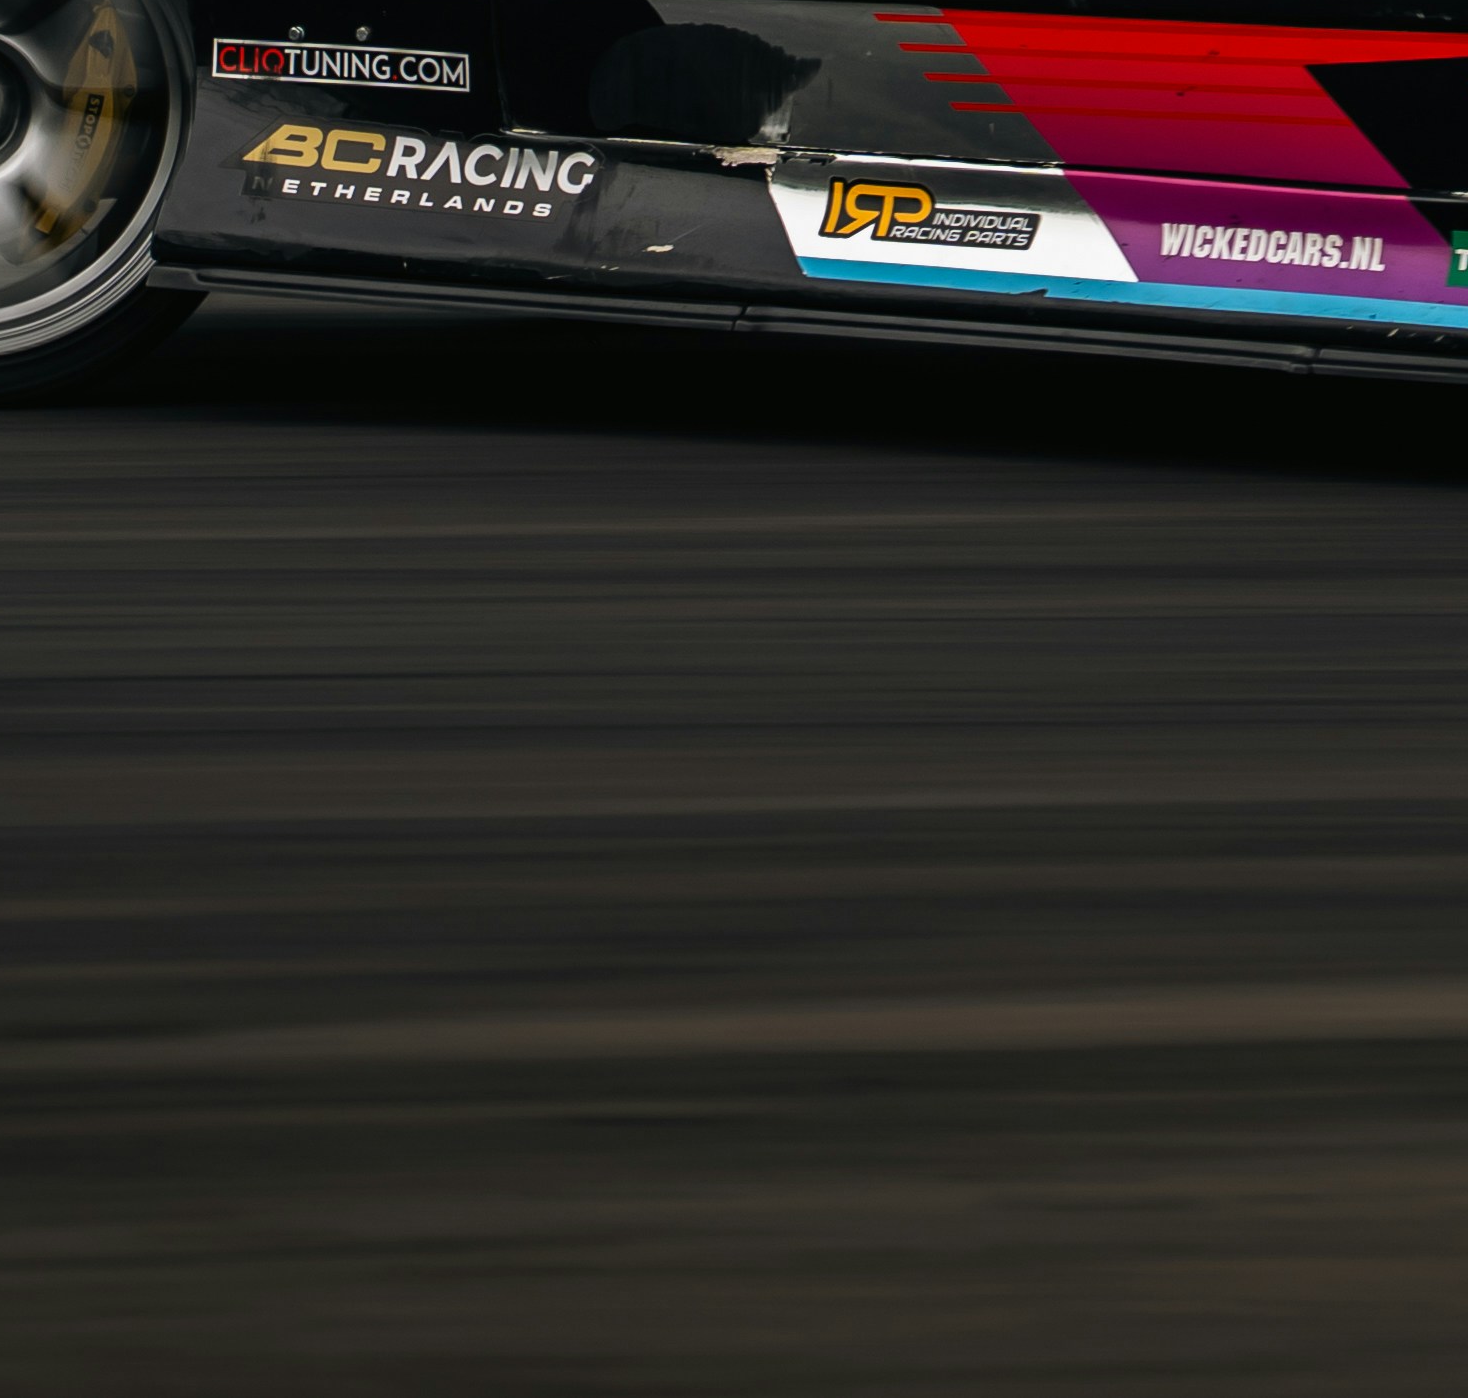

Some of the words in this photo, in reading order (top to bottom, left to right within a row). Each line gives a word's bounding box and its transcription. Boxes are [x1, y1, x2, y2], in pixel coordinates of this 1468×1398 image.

[933, 213, 1033, 232] INDIVIDUAL
[890, 226, 961, 242] RACING
[964, 230, 1031, 247] PARTS
[1160, 223, 1385, 272] WICKEDCARS.NL
